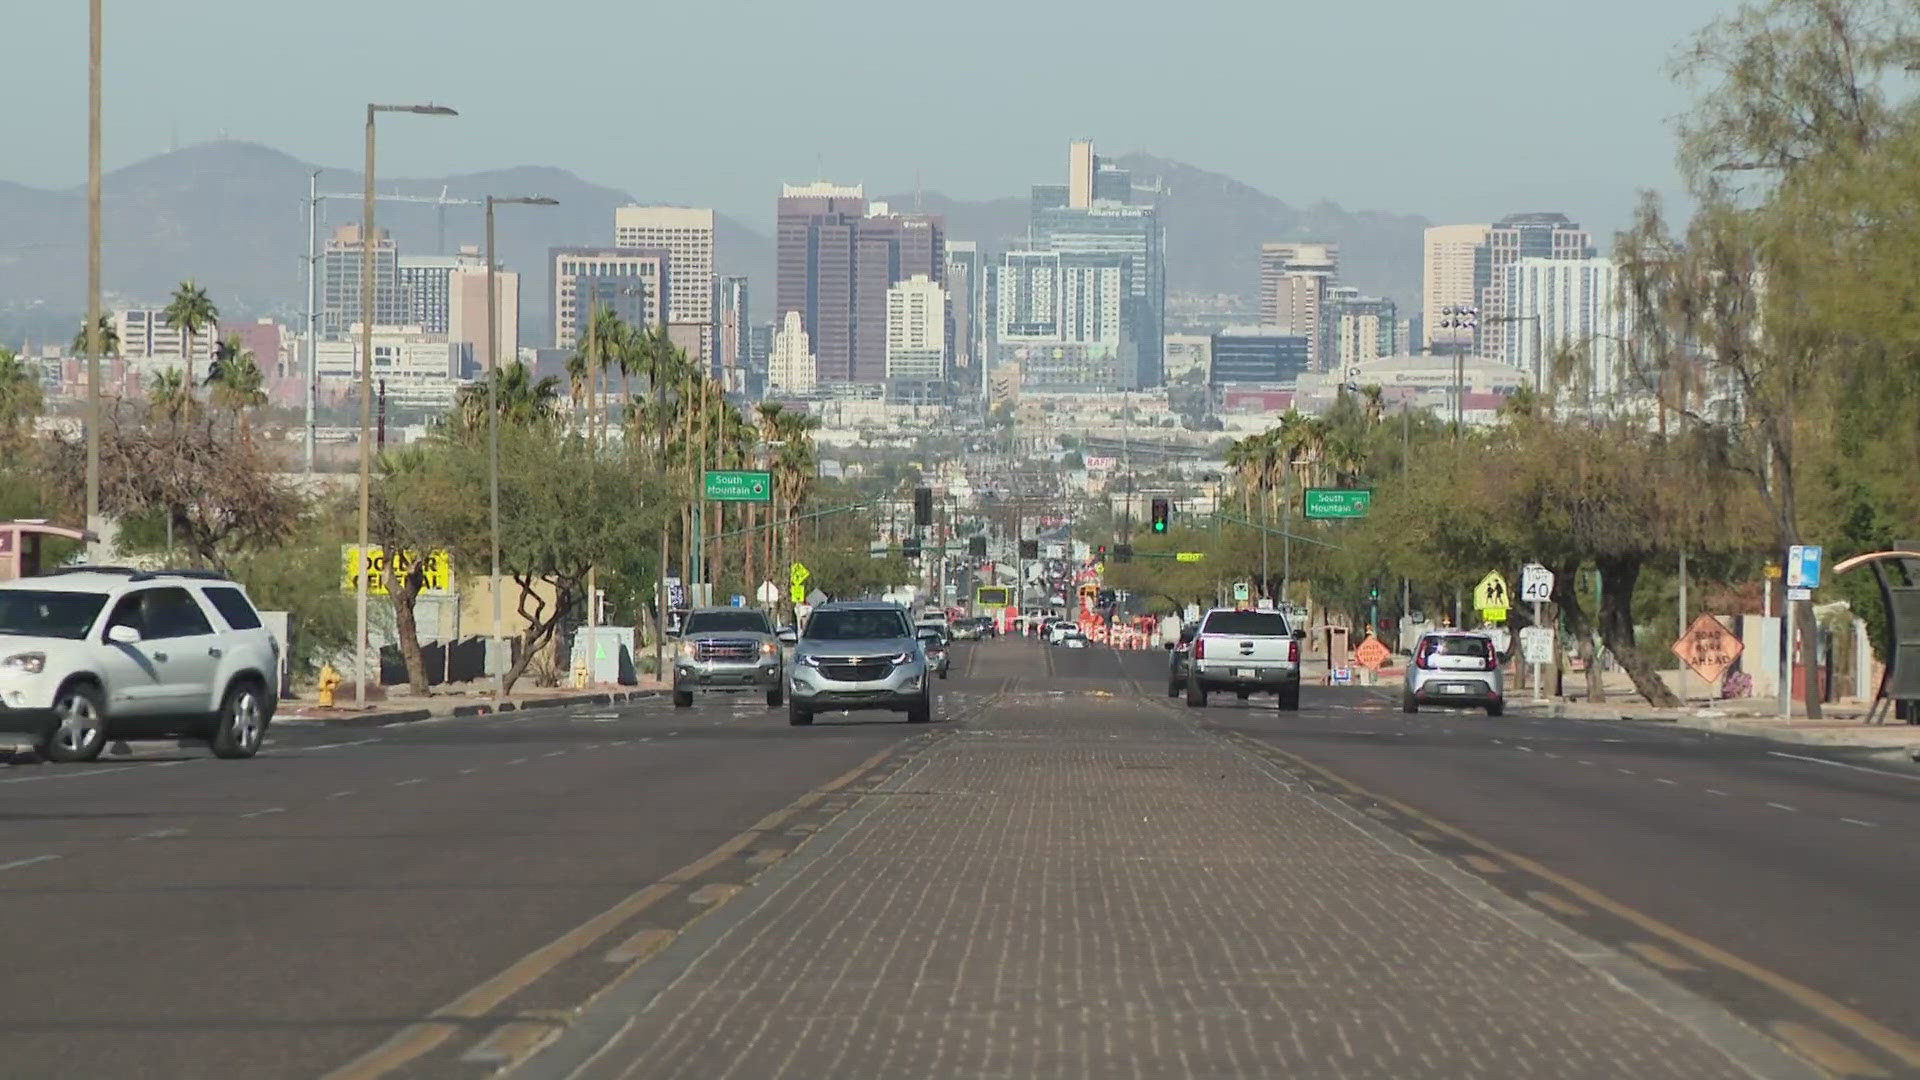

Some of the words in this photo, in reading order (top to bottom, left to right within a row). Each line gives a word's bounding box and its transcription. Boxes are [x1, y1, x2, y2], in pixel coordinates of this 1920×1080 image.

[715, 475, 743, 485] South
[707, 486, 751, 496] Mountain
[1318, 494, 1344, 502] South
[1310, 504, 1351, 512] Mountain
[1526, 583, 1549, 599] 40
[1694, 631, 1721, 640] ROAD
[1691, 655, 1730, 666] AHEAD
